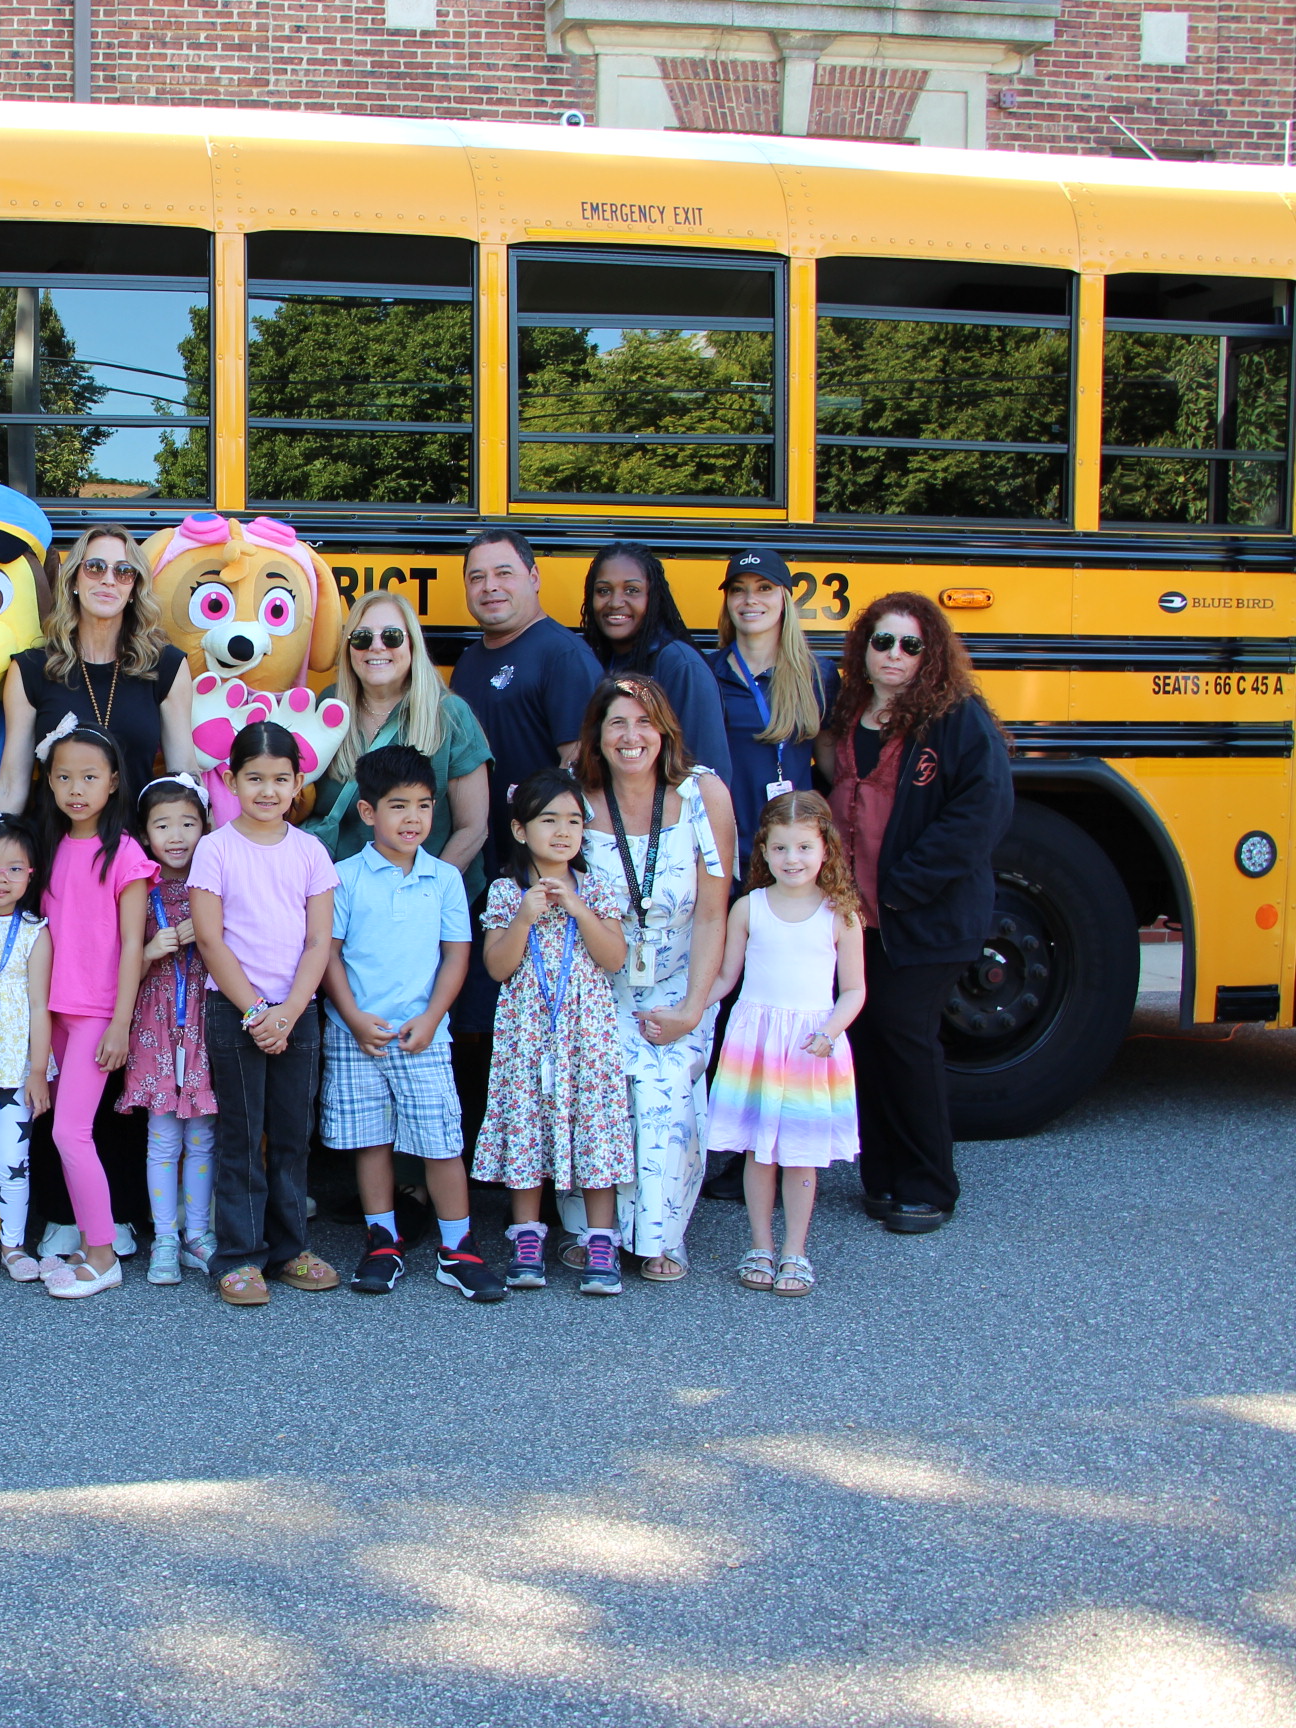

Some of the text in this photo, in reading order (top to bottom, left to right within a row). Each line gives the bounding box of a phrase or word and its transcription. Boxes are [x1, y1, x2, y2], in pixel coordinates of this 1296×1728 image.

[581, 201, 703, 226] EMERGENCY EXIT
[739, 553, 761, 566] alo
[1192, 597, 1274, 609] BLUE BIRD
[1152, 675, 1200, 695] SEATS
[1214, 675, 1232, 695] 66
[1236, 675, 1246, 695] C
[1251, 675, 1269, 695] 45
[1273, 675, 1284, 695] A
